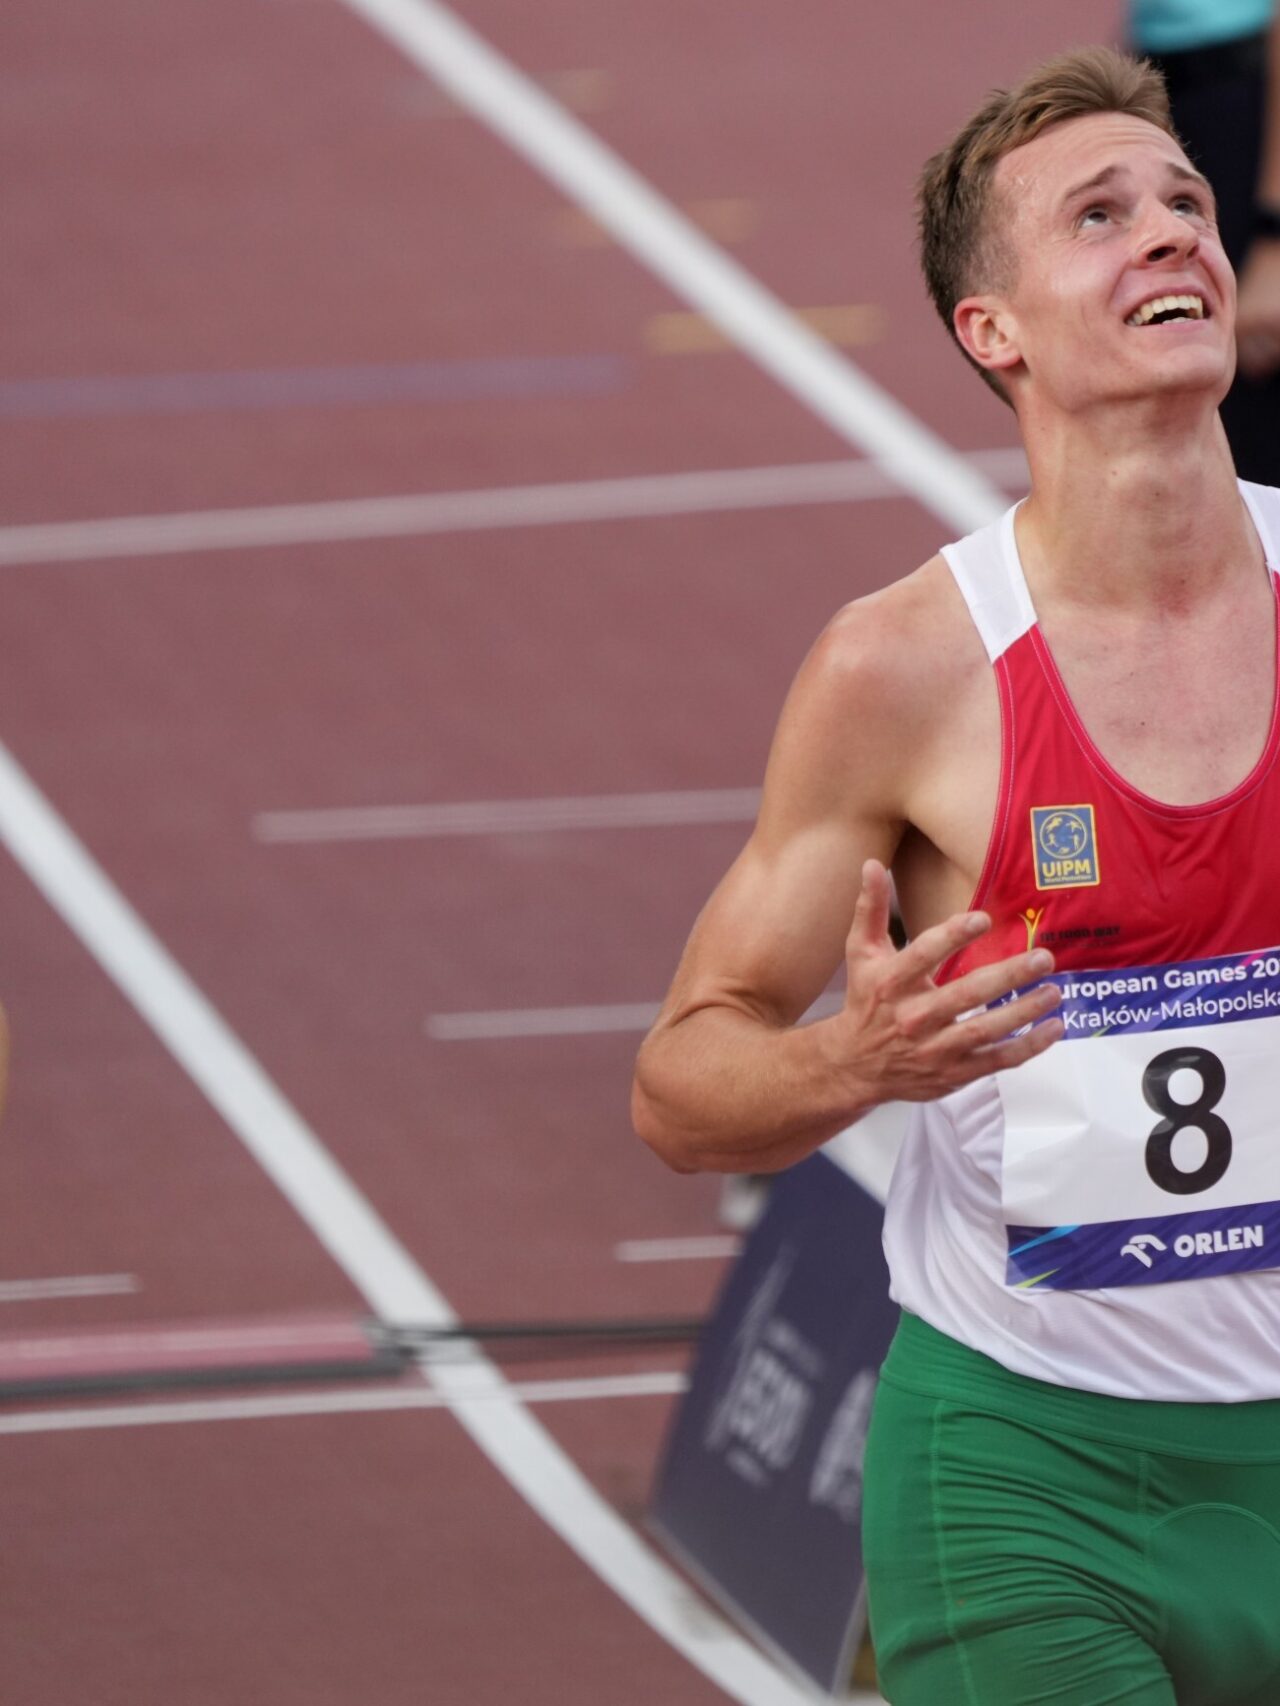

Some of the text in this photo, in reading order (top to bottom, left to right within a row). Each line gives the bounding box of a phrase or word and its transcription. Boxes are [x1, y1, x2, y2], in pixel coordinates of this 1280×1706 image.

[1042, 859, 1091, 878] UIPM
[1040, 975, 1157, 1001] uropean
[1163, 964, 1248, 989] Games
[1141, 1046, 1233, 1196] 8
[1173, 1224, 1265, 1259] ORLEN
